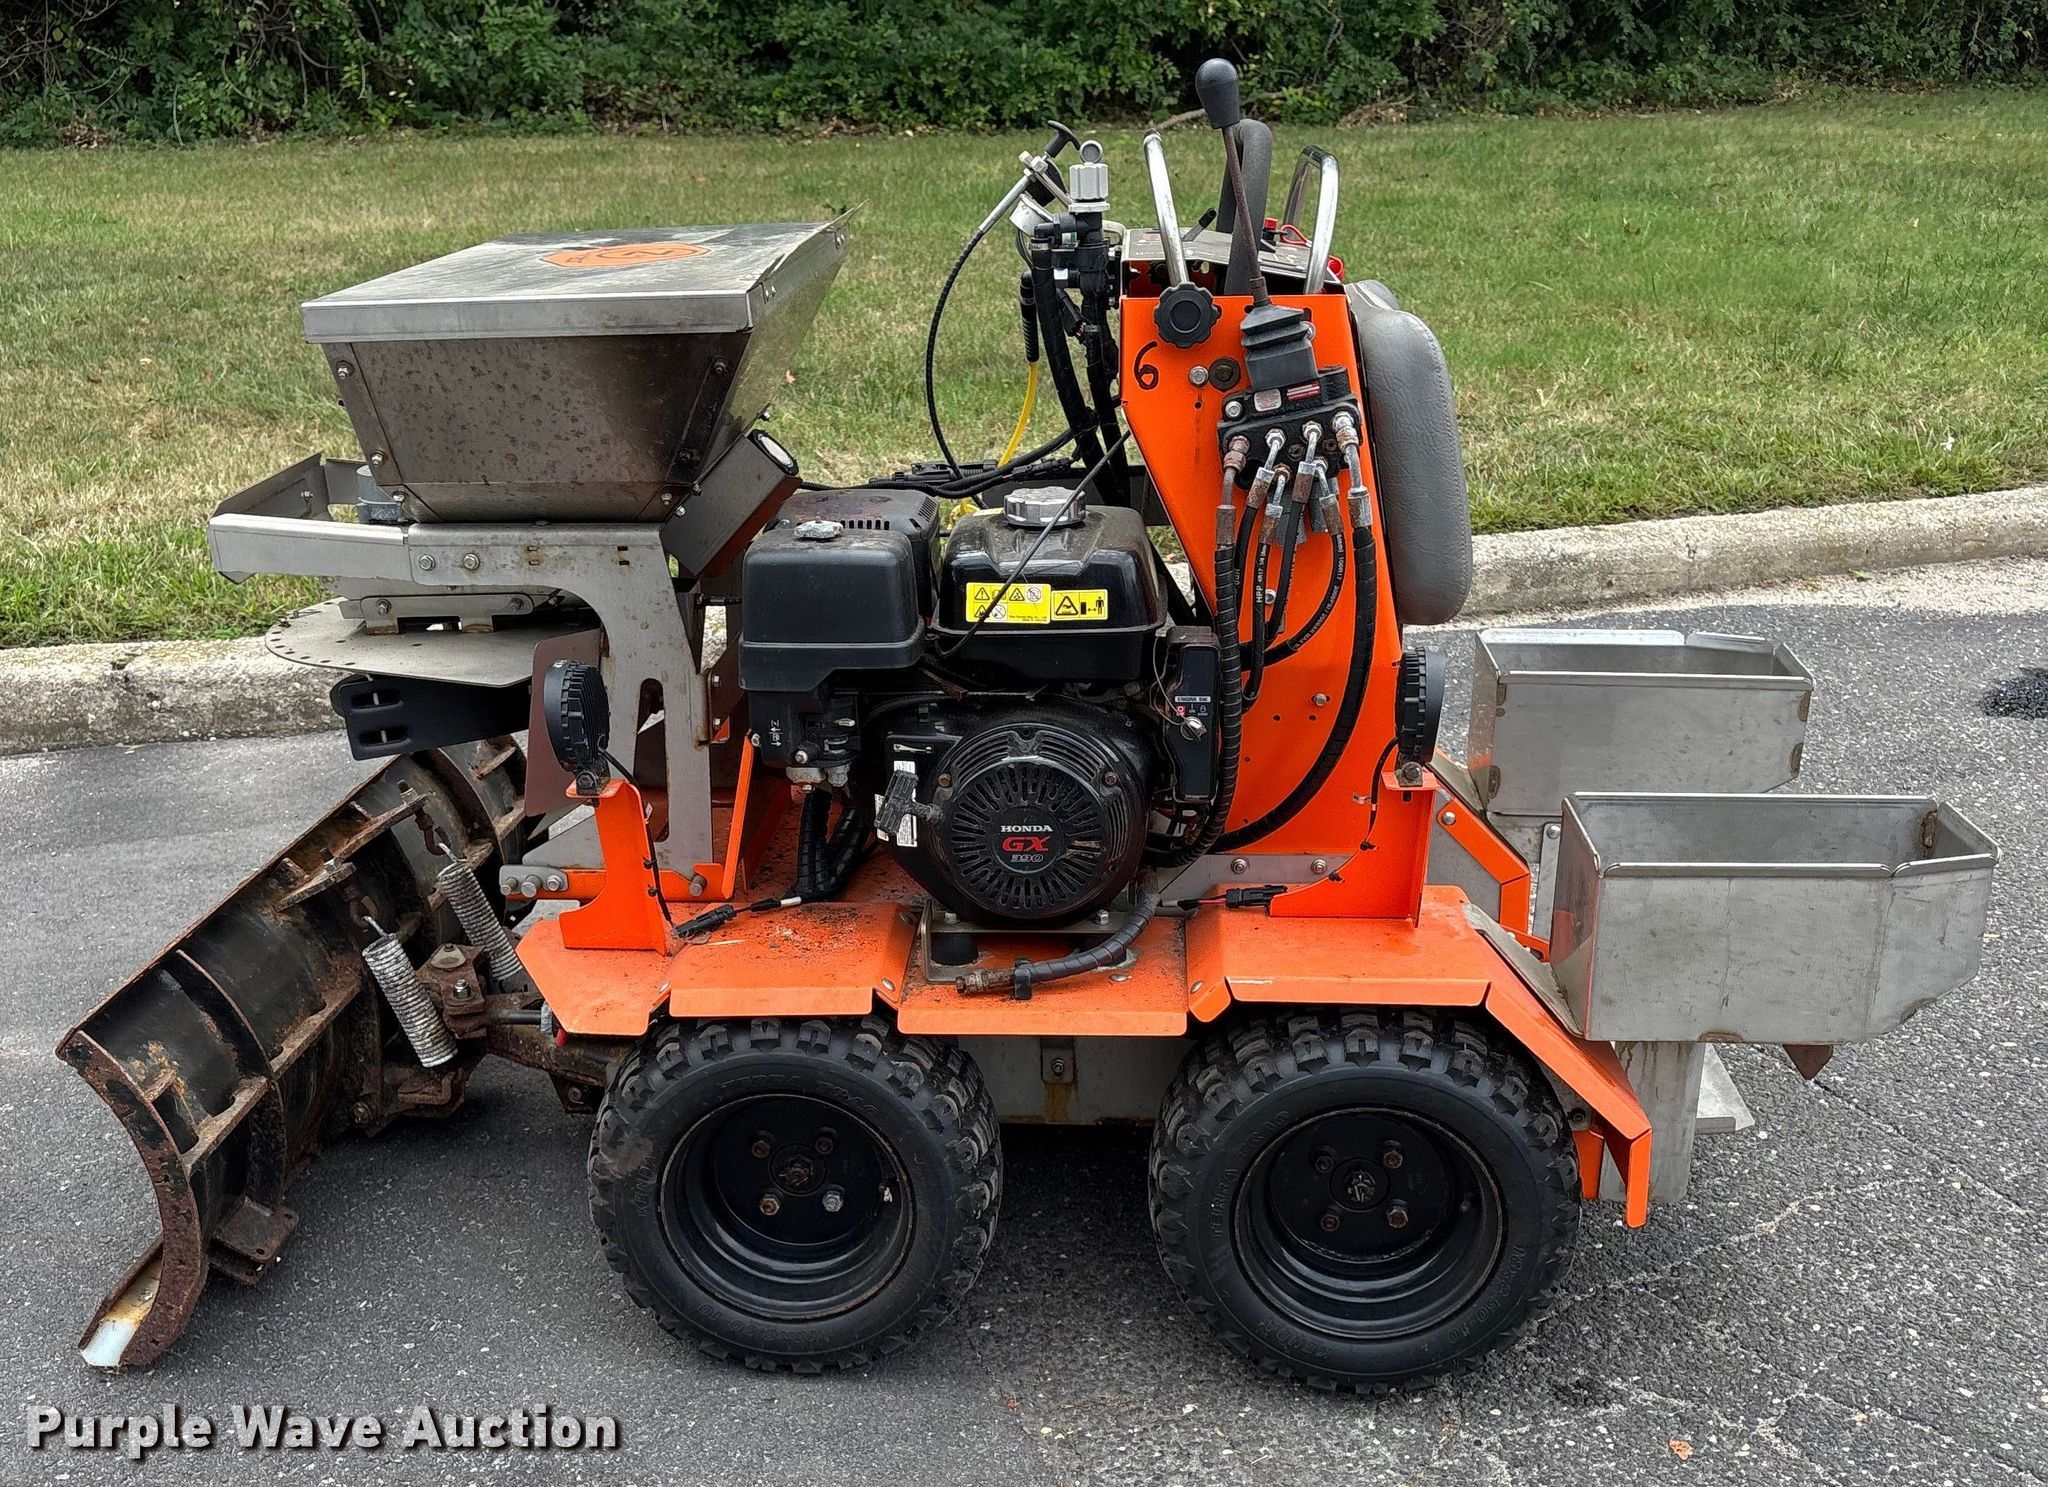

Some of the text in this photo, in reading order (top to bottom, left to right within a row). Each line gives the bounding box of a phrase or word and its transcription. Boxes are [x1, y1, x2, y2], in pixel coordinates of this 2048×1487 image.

[1134, 341, 1158, 390] 6
[1003, 836, 1051, 852] GX
[1010, 854, 1044, 862] 390
